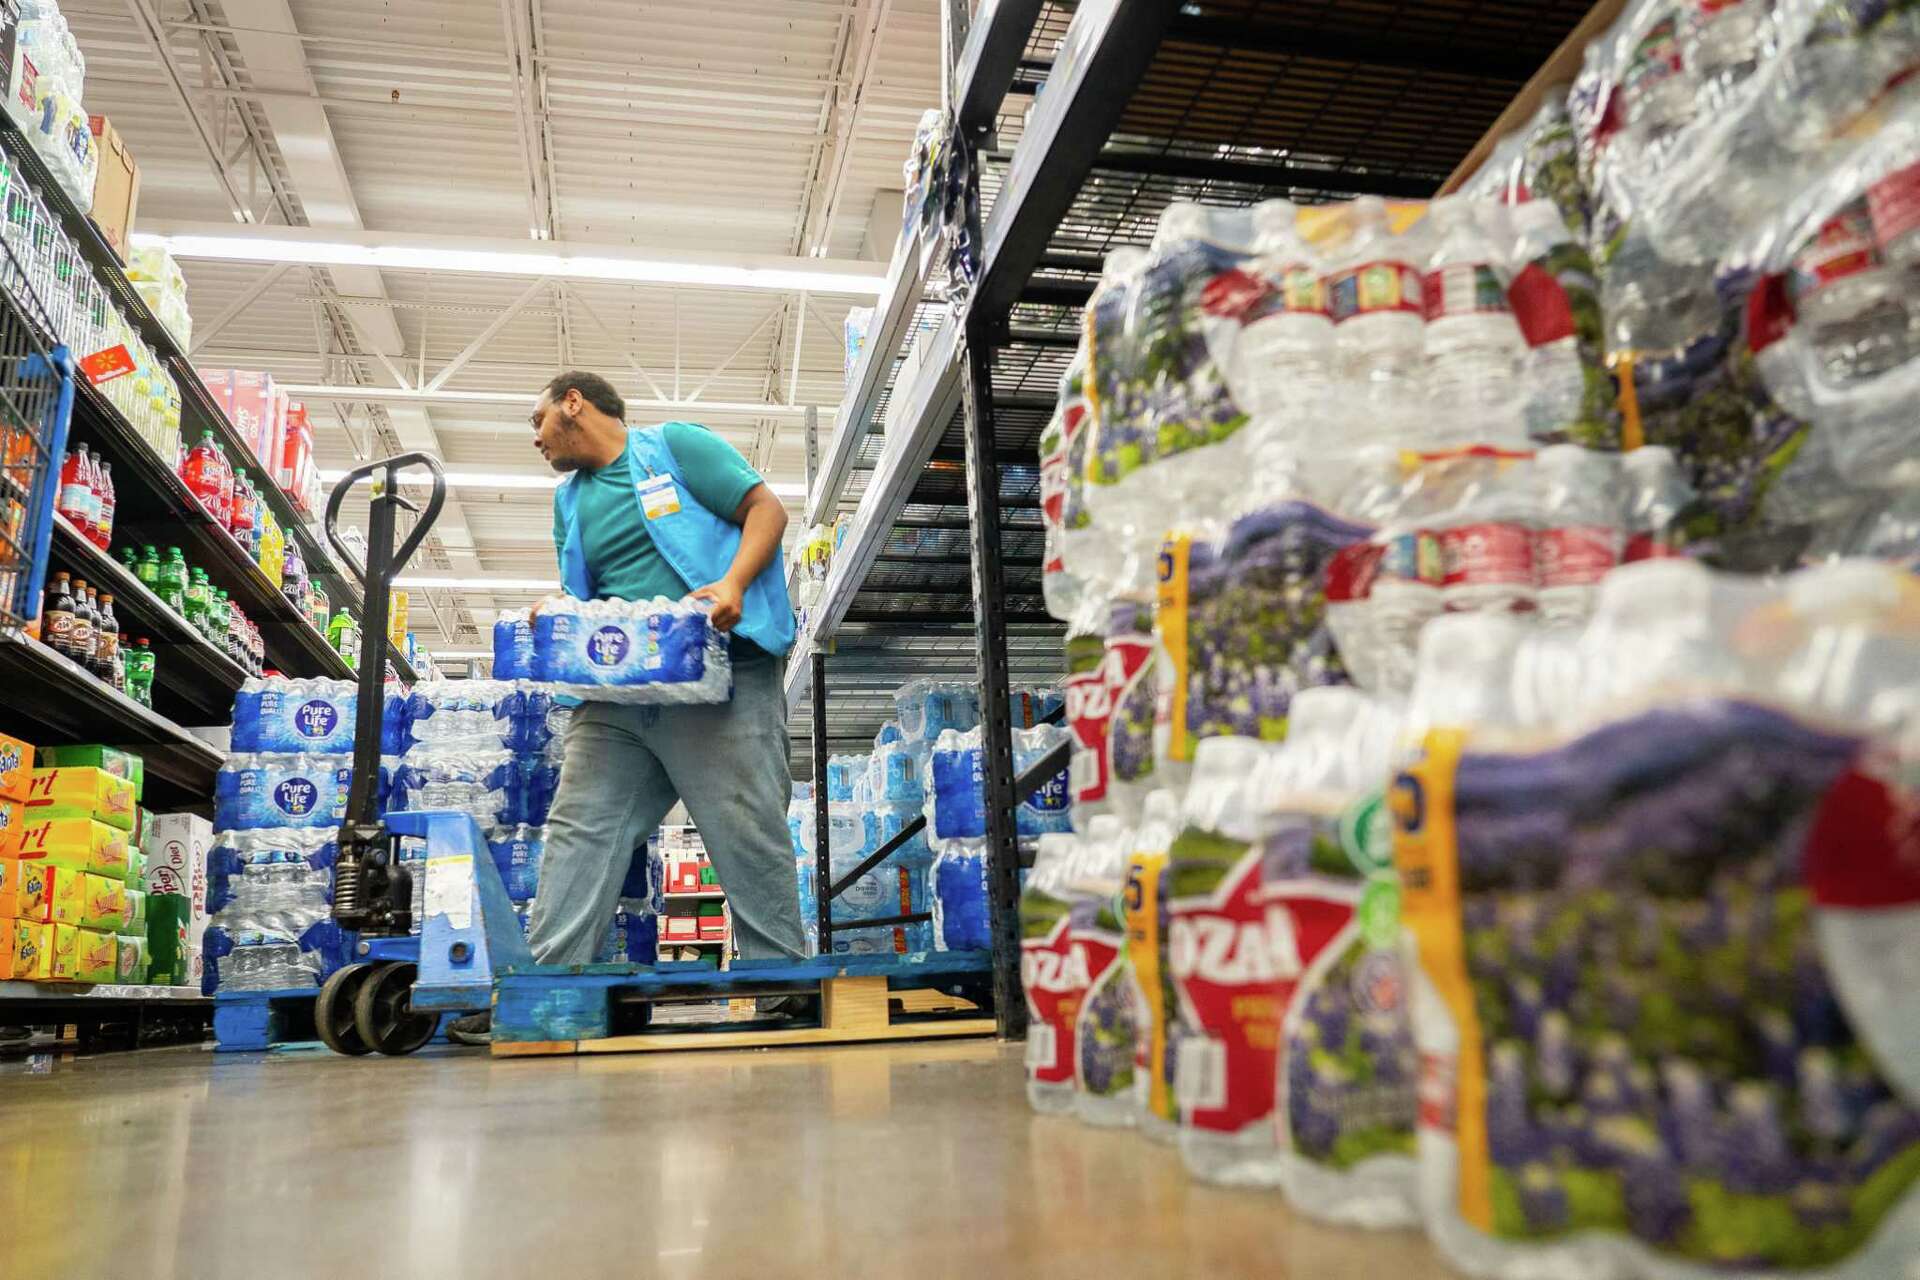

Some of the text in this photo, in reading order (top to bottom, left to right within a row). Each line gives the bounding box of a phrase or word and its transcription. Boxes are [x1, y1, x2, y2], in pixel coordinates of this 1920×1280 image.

[302, 704, 332, 716] Pure
[304, 714, 328, 728] Life
[281, 782, 311, 795] Pure
[284, 792, 307, 805] Life
